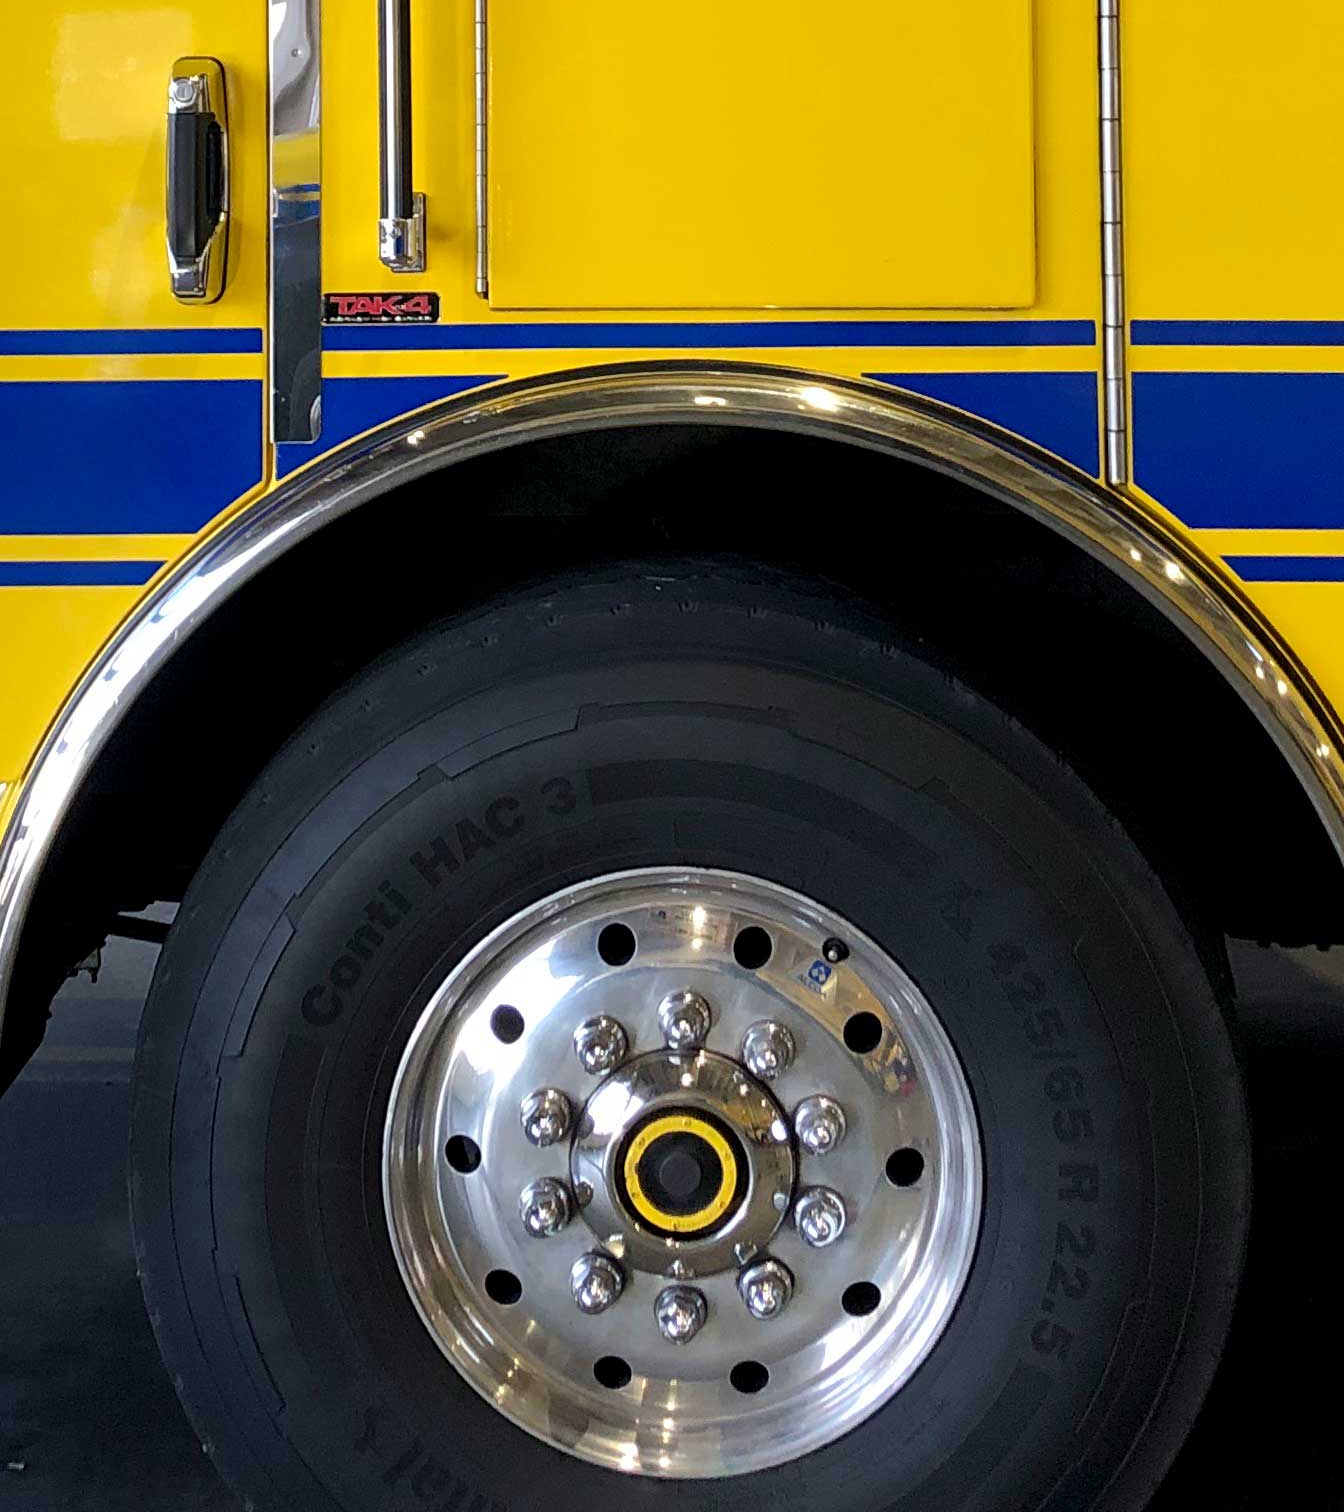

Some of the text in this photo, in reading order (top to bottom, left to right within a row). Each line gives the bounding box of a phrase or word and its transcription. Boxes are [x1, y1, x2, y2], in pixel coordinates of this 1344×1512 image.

[301, 776, 578, 1027] Conti HAC 3
[1057, 1162, 1100, 1203] R
[1029, 1221, 1097, 1362] 22.5
